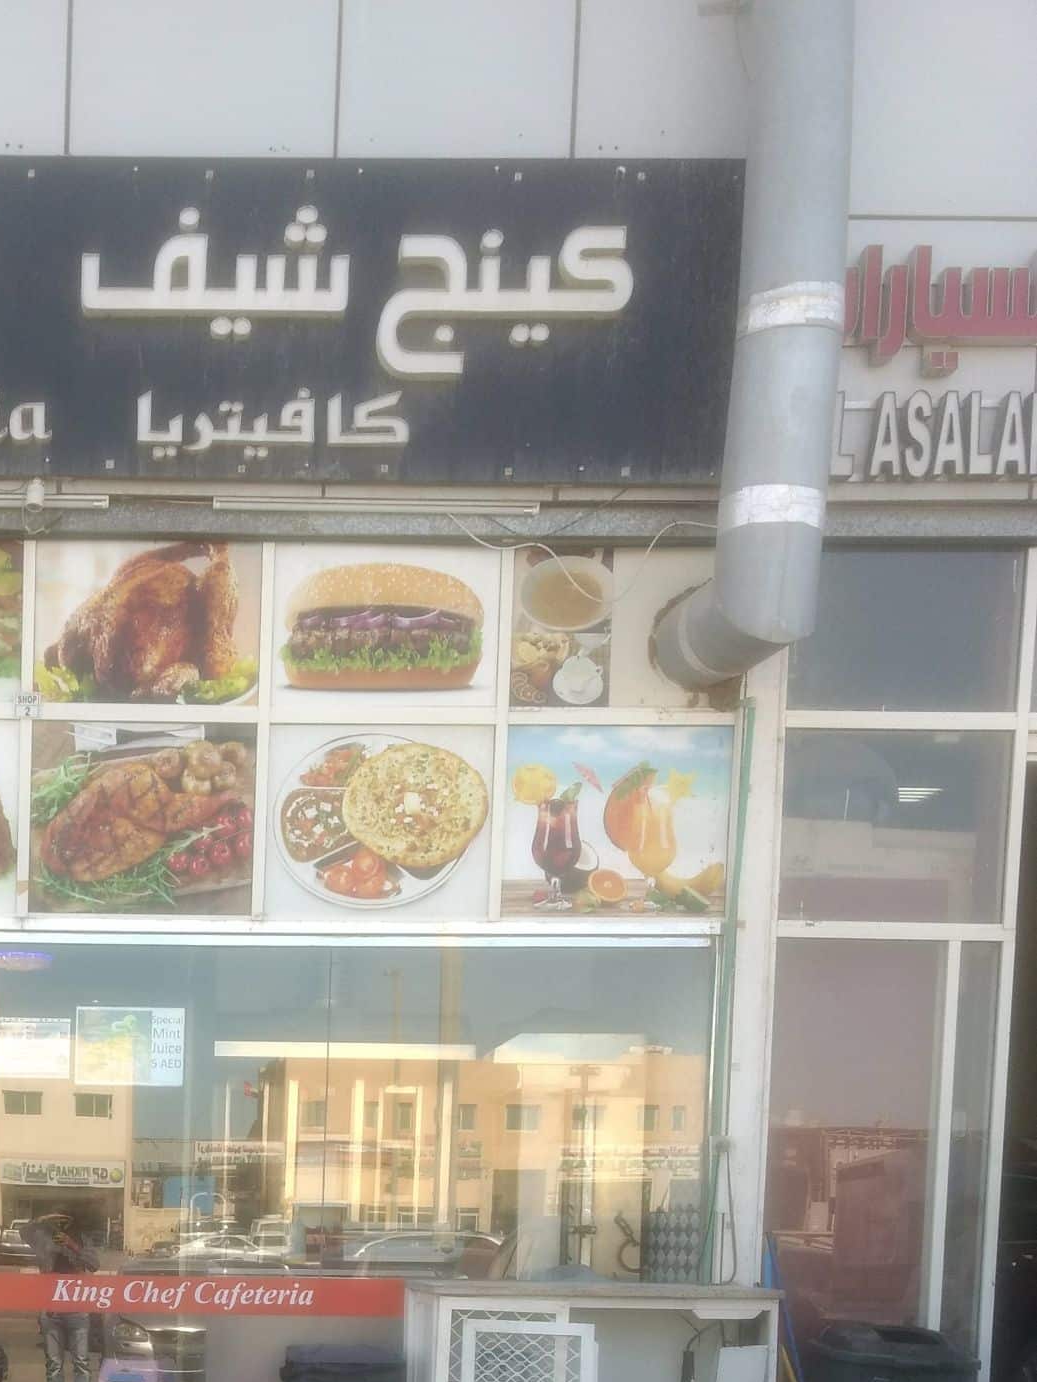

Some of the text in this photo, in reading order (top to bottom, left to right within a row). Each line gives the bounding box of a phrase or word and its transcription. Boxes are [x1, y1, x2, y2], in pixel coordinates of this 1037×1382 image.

[80, 204, 635, 376] كينج شيف
[135, 386, 412, 460] كافيتريا
[17, 695, 37, 705] SHOP
[24, 706, 30, 716] 2
[150, 1015, 184, 1026] Special
[153, 1027, 181, 1039] Mint
[152, 1042, 182, 1054] Juice
[161, 1059, 182, 1069] AED
[51, 1279, 314, 1311] King Chef Cafeteria
